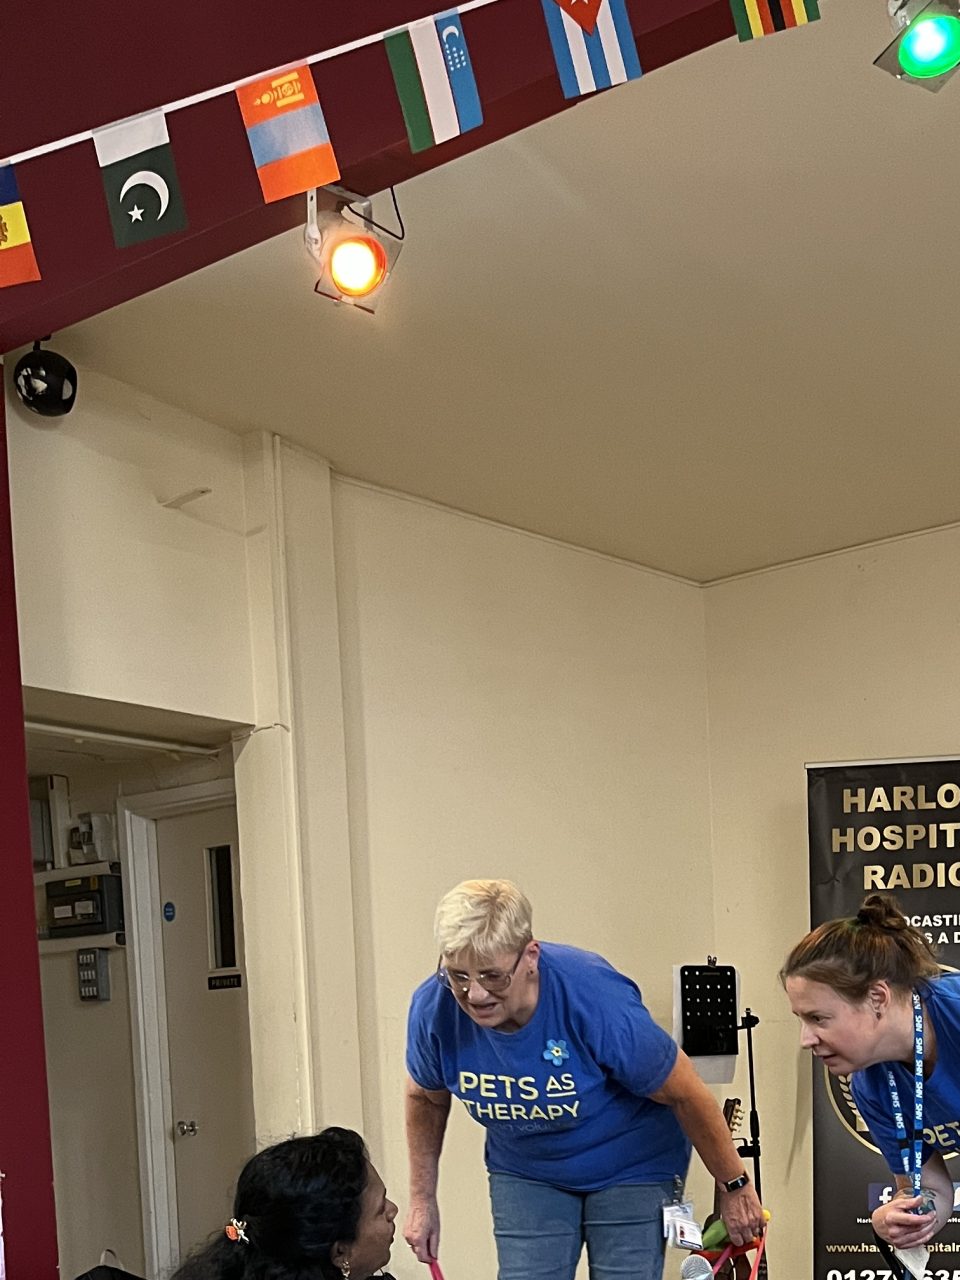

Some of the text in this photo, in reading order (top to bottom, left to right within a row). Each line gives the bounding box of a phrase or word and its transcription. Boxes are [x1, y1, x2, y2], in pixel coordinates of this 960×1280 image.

[937, 931, 949, 945] A
[915, 1015, 923, 1033] NHS
[915, 1037, 923, 1055] NHS
[915, 1059, 923, 1077] NHS
[459, 1071, 577, 1101] PETS AS
[915, 1081, 923, 1099] NHS
[890, 1091, 901, 1109] NHS
[461, 1100, 580, 1121] THERAPY
[915, 1103, 923, 1121] NHS
[894, 1112, 905, 1130] NHS
